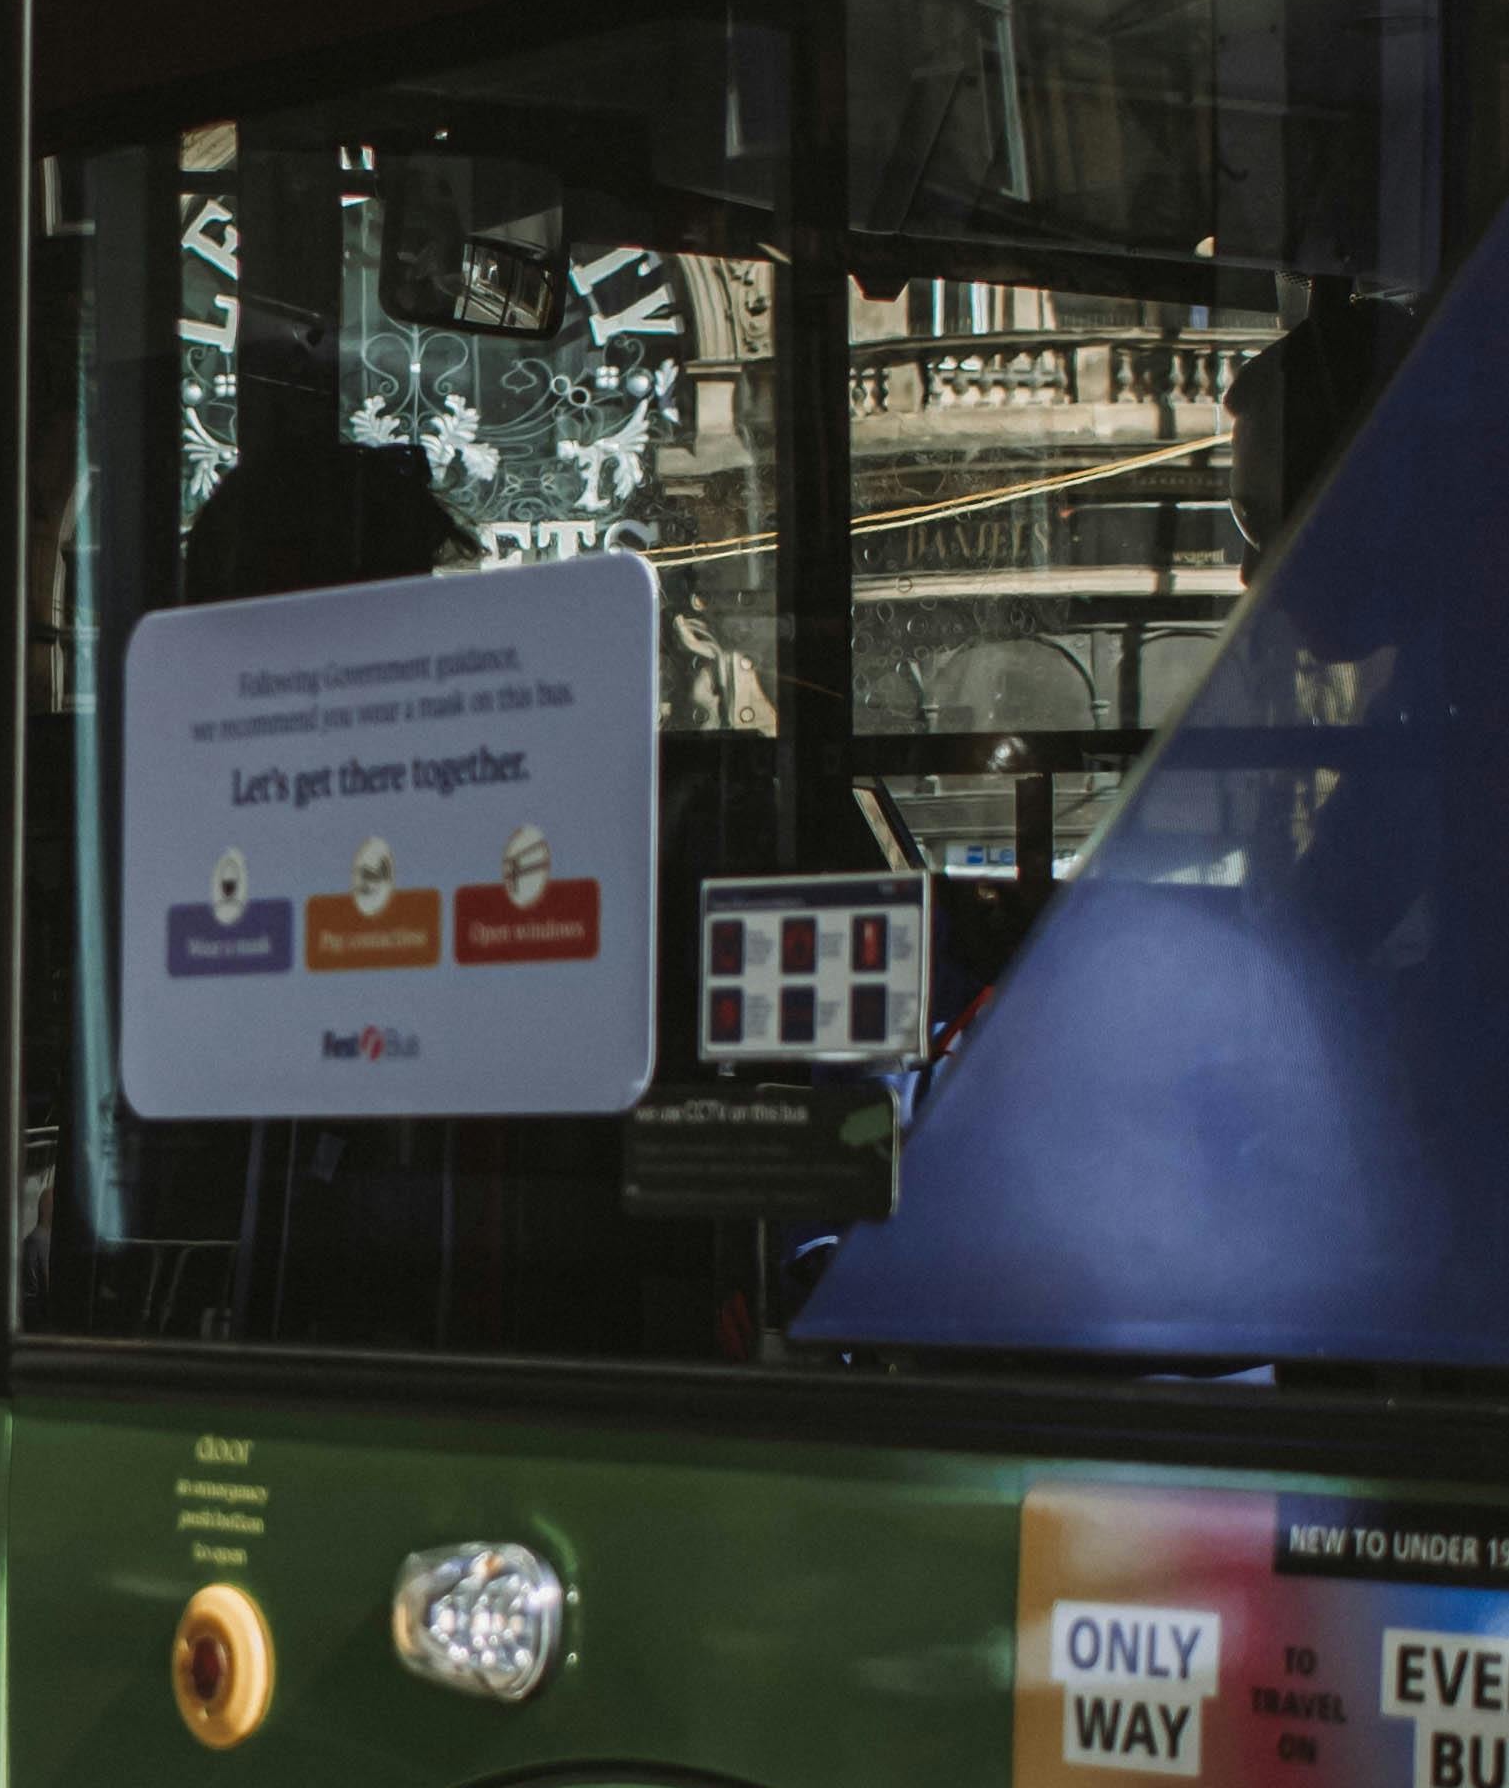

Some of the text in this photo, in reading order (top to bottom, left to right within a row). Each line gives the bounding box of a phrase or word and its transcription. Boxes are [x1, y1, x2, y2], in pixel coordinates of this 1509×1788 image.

[293, 764, 333, 811] get
[338, 756, 407, 797] there
[194, 1432, 254, 1466] door
[1288, 1523, 1348, 1555] NEW
[1352, 1526, 1389, 1559] TO
[1392, 1530, 1480, 1568] UNDER
[1067, 1614, 1202, 1681] ONLY
[1283, 1643, 1318, 1676] TO
[1395, 1643, 1509, 1712] EVE
[1073, 1695, 1192, 1761] WAY
[1250, 1686, 1347, 1725] TRAVEL
[1277, 1733, 1318, 1766] ON
